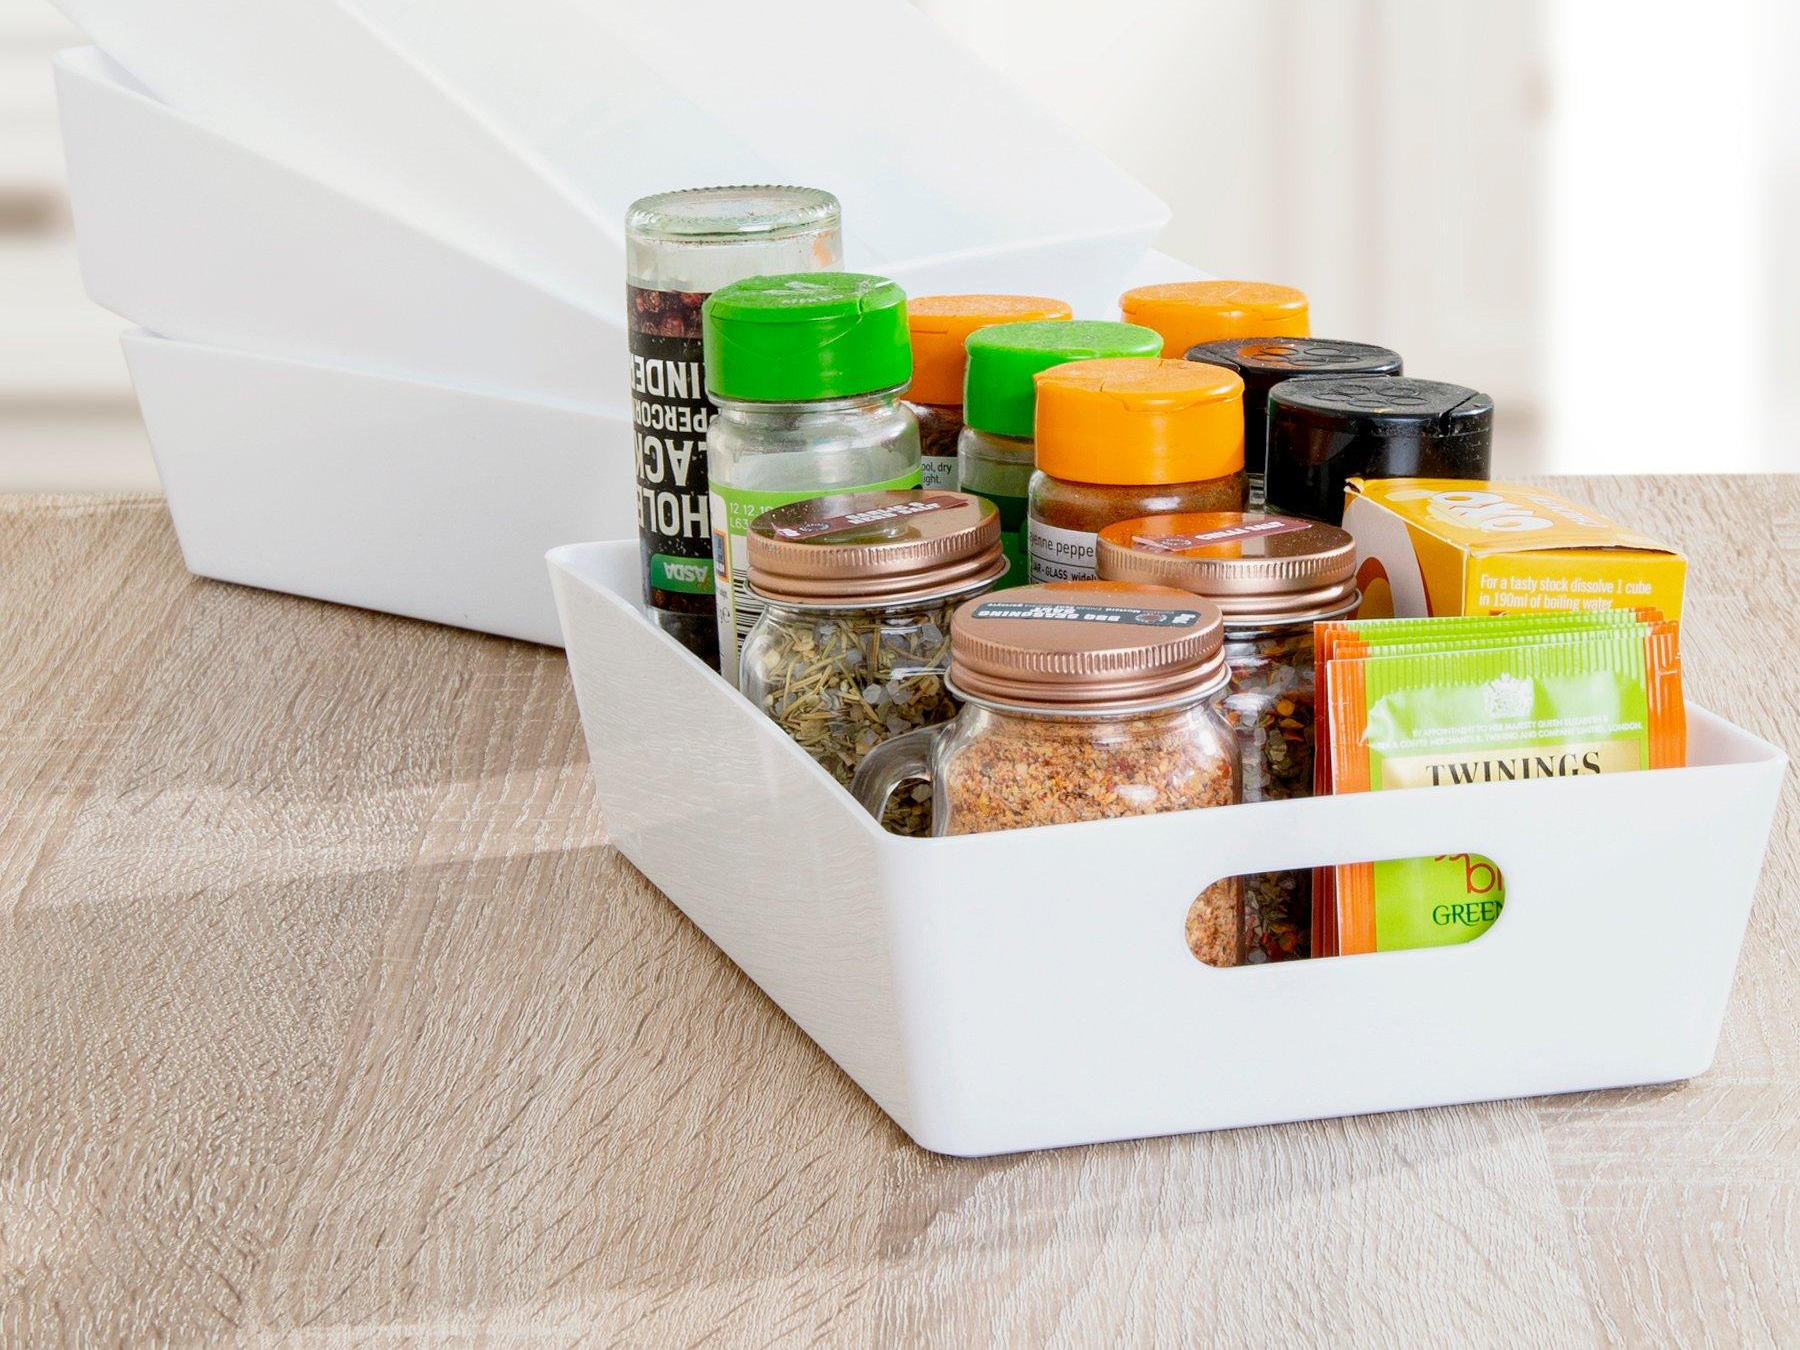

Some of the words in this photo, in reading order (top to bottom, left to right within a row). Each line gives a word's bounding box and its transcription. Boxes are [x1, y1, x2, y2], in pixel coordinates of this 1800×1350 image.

[630, 353, 706, 399] INDE
[633, 434, 708, 487] ACK
[937, 462, 952, 475] dry
[923, 473, 942, 486] ight.
[637, 483, 711, 538] HOLE
[730, 502, 739, 514] 12
[1056, 542, 1095, 560] peppe
[661, 561, 709, 584] ASDA
[1071, 571, 1097, 581] widel
[1480, 573, 1498, 590] For
[1499, 578, 1508, 590] a
[1510, 576, 1538, 593] tasty
[1540, 577, 1569, 592] stock
[1570, 577, 1615, 594] dissolve
[1616, 579, 1623, 594] 1
[1624, 580, 1653, 595] cube
[1479, 592, 1490, 607] in
[1493, 592, 1528, 609] 190ml
[1529, 594, 1542, 608] of
[1543, 594, 1581, 611] boiling
[1537, 717, 1562, 729] QUEEN
[1520, 729, 1537, 739] AND
[1425, 751, 1601, 787] TWININGS
